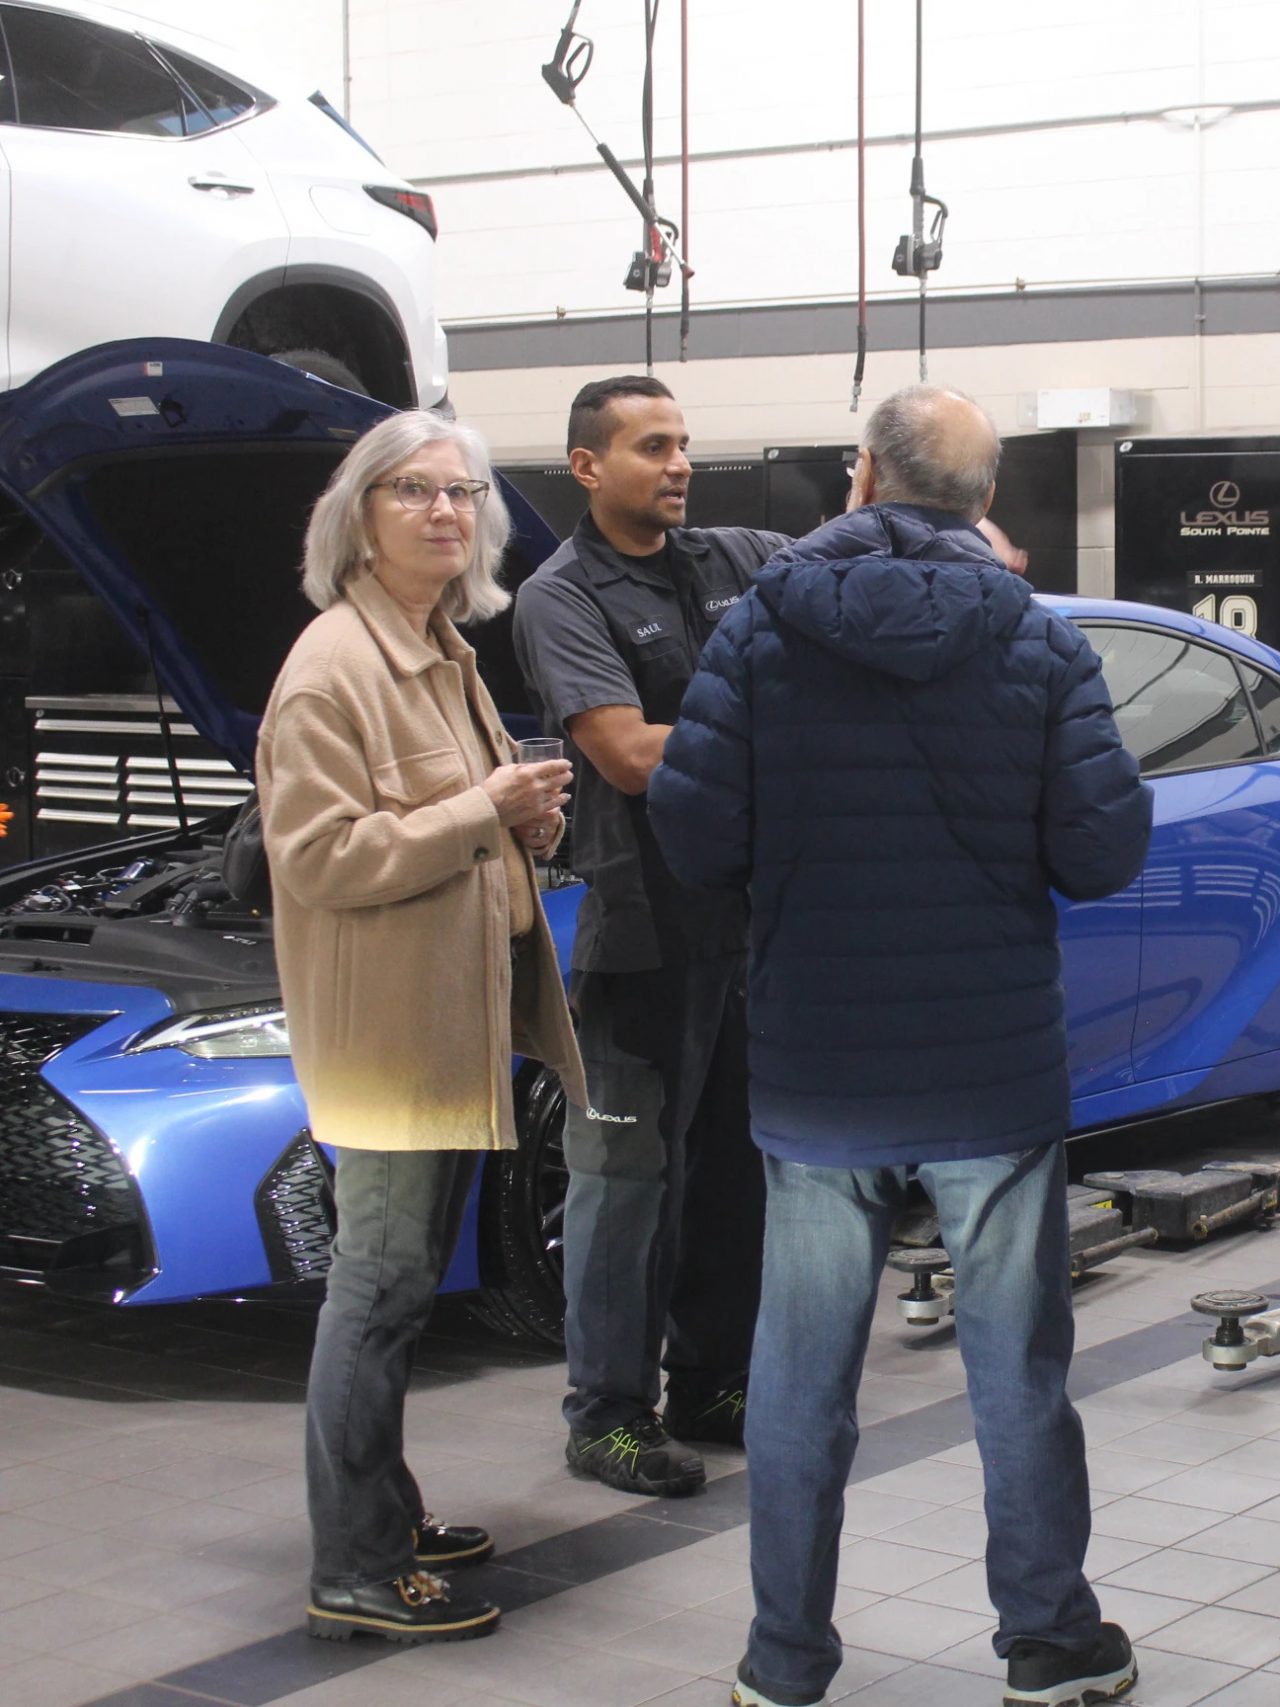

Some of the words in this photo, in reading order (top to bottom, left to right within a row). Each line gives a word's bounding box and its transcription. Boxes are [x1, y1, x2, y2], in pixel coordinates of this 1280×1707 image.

[1180, 510, 1270, 526] LEXUS
[636, 622, 663, 638] SAUL
[596, 1112, 637, 1123] LEXUS
